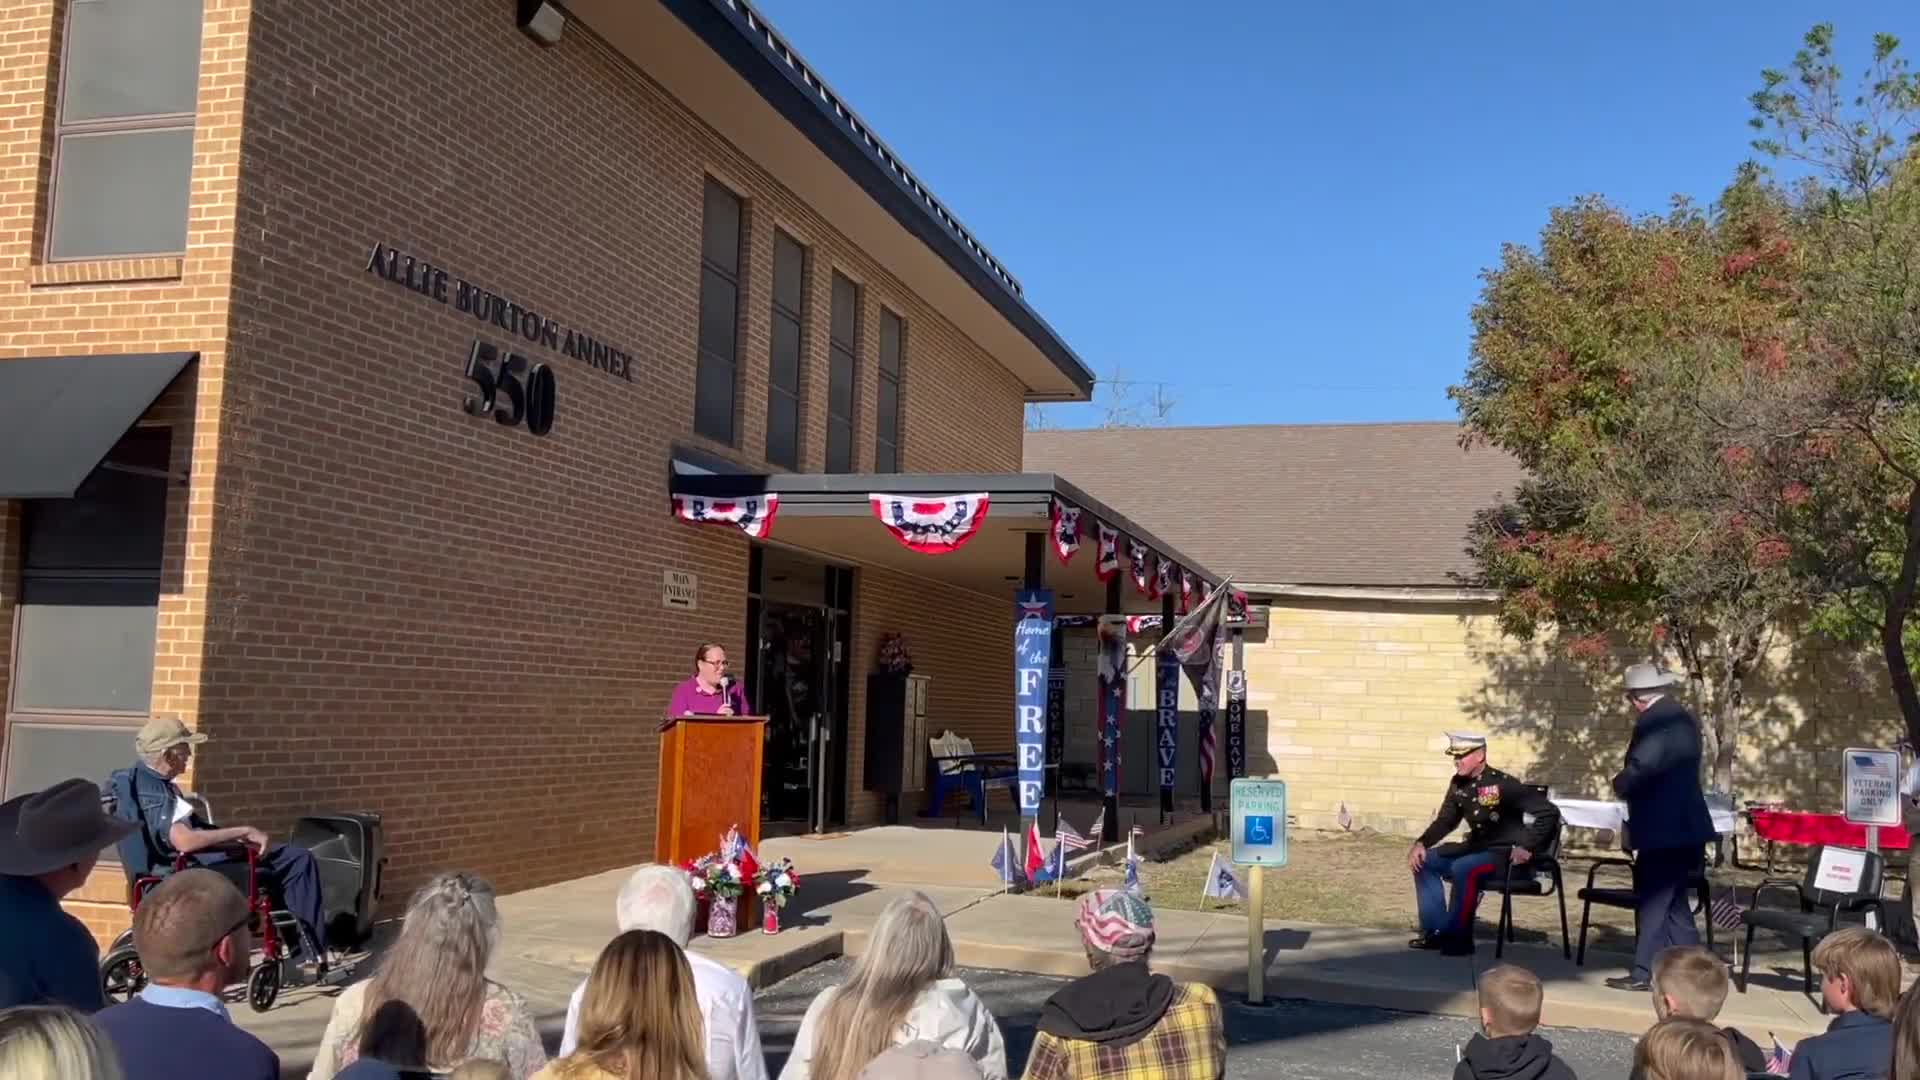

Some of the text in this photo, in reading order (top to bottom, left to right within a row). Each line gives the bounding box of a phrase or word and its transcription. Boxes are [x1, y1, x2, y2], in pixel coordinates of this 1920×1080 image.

[366, 241, 633, 383] ALLIE BURTON ANNEX
[464, 338, 556, 436] 550
[672, 572, 690, 585] MAIN
[664, 584, 696, 599] ENTRANCE
[1015, 619, 1049, 636] Home
[1017, 638, 1030, 656] of
[1030, 650, 1049, 665] the
[1018, 668, 1044, 809] FREE
[1159, 689, 1176, 786] BRAVE
[1230, 694, 1241, 776] SOME GAVE
[1853, 778, 1891, 789] VETERAN
[1235, 785, 1282, 798] RESERVED
[1853, 788, 1891, 798] PARKING
[1239, 800, 1280, 813] PARKING
[1861, 798, 1884, 806] ONLY
